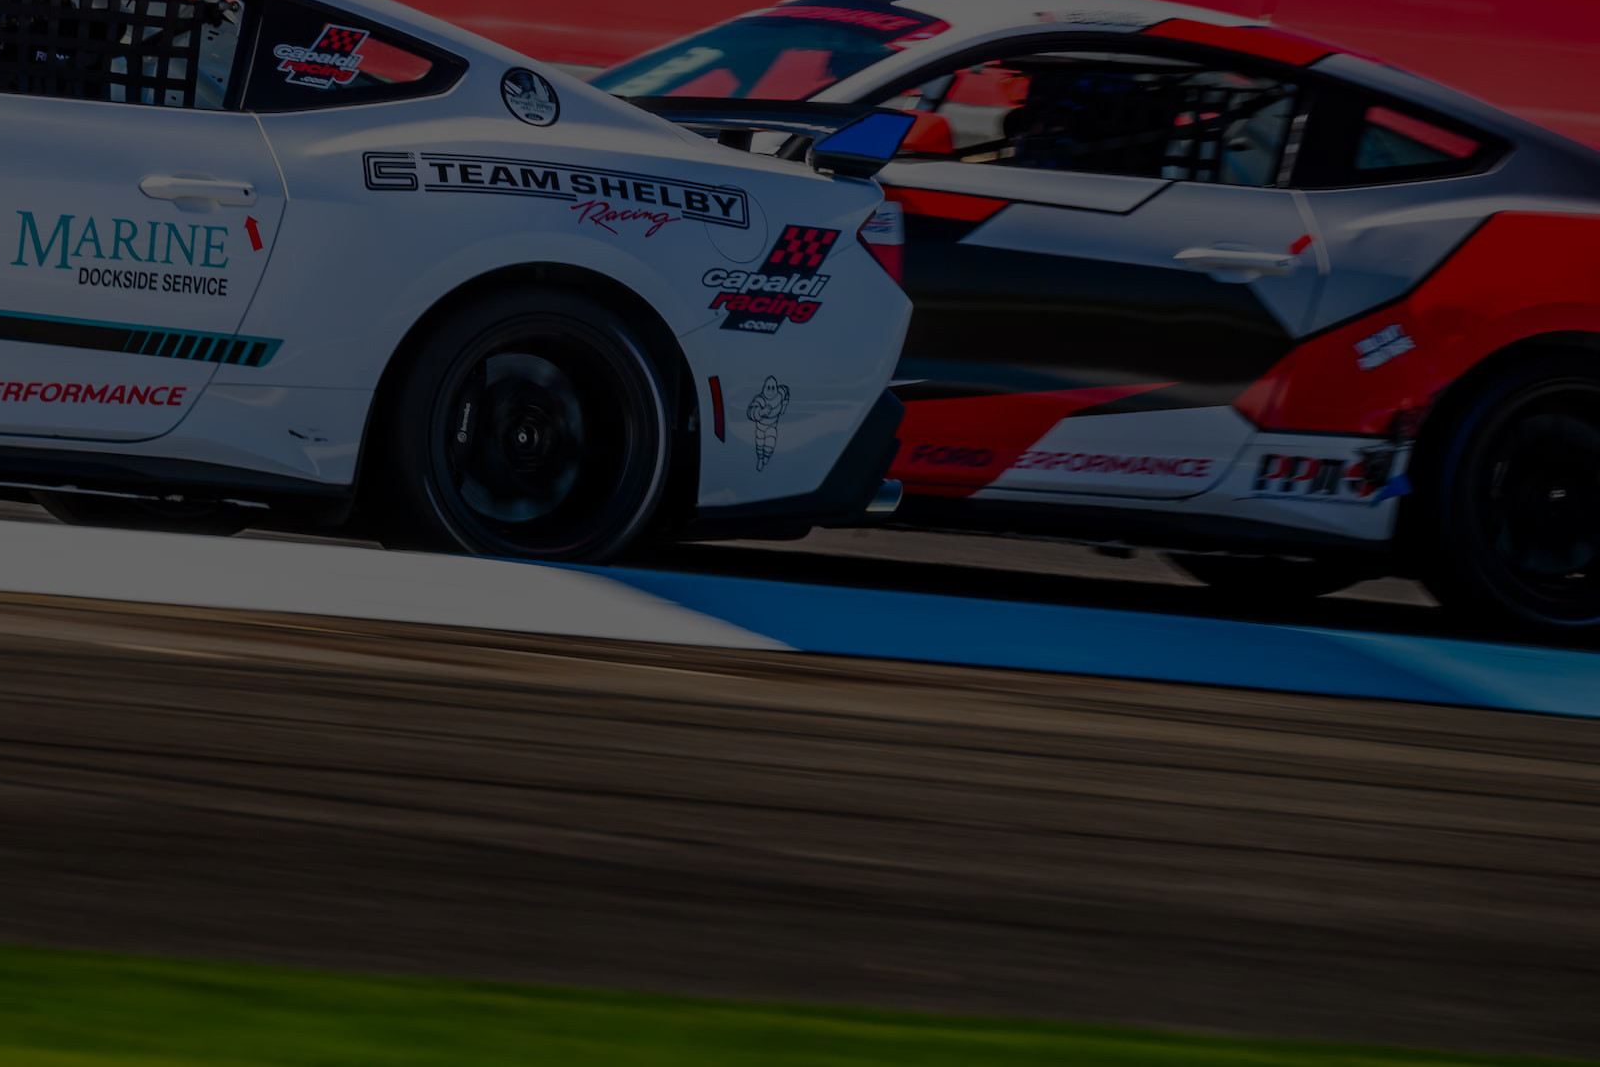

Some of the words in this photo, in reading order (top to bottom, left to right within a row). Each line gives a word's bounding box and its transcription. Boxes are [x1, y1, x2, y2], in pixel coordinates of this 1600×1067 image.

[273, 44, 363, 68] capaldi
[281, 60, 357, 82] racing
[429, 161, 561, 191] TEAM
[570, 174, 738, 218] SHELBY
[570, 199, 681, 238] Racing
[10, 210, 230, 270] MARINE
[78, 267, 158, 291] DOCKSIDE
[162, 274, 228, 296] SERVICE
[703, 269, 830, 297] capaldi
[709, 292, 821, 323] racing
[739, 320, 778, 332] .com
[1013, 450, 1216, 478] ERFORMANCE
